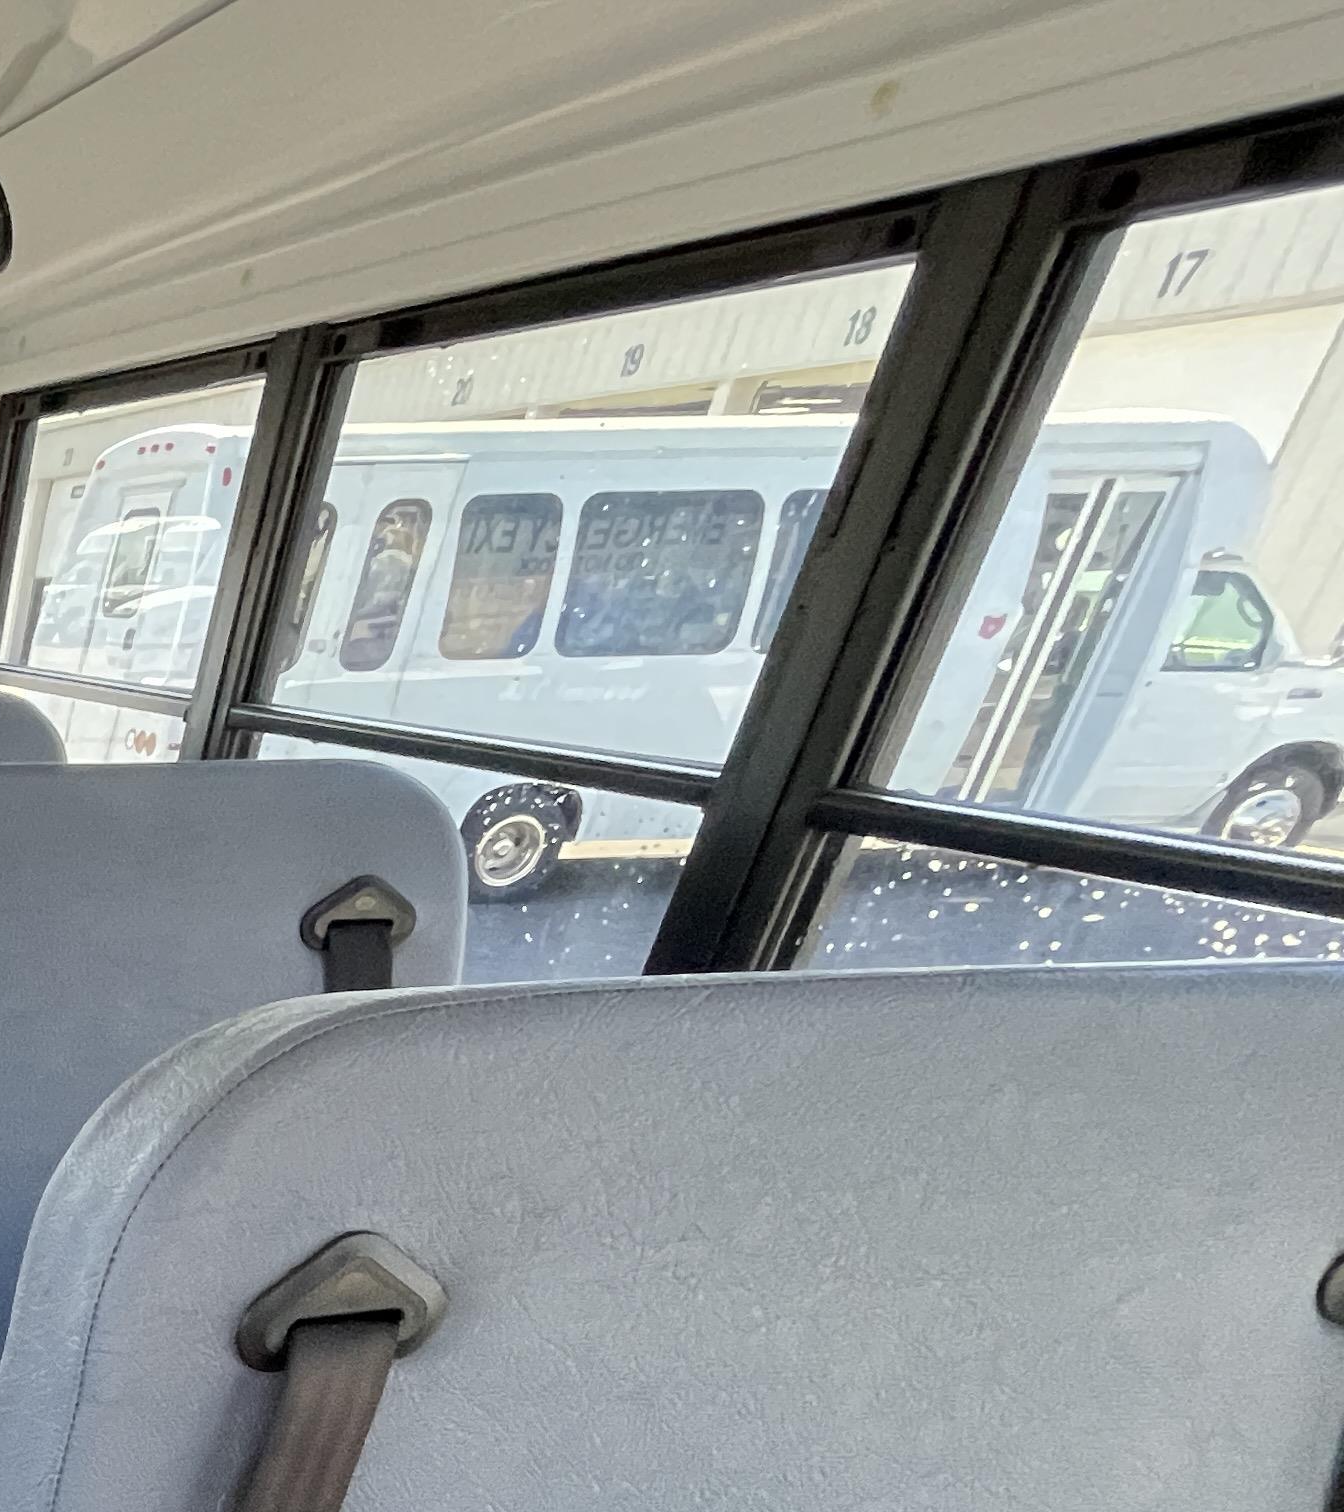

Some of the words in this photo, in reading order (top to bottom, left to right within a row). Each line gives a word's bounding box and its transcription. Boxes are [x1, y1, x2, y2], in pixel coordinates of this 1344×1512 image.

[1157, 248, 1210, 299] 17
[843, 306, 877, 348] 18
[620, 343, 645, 378] 19
